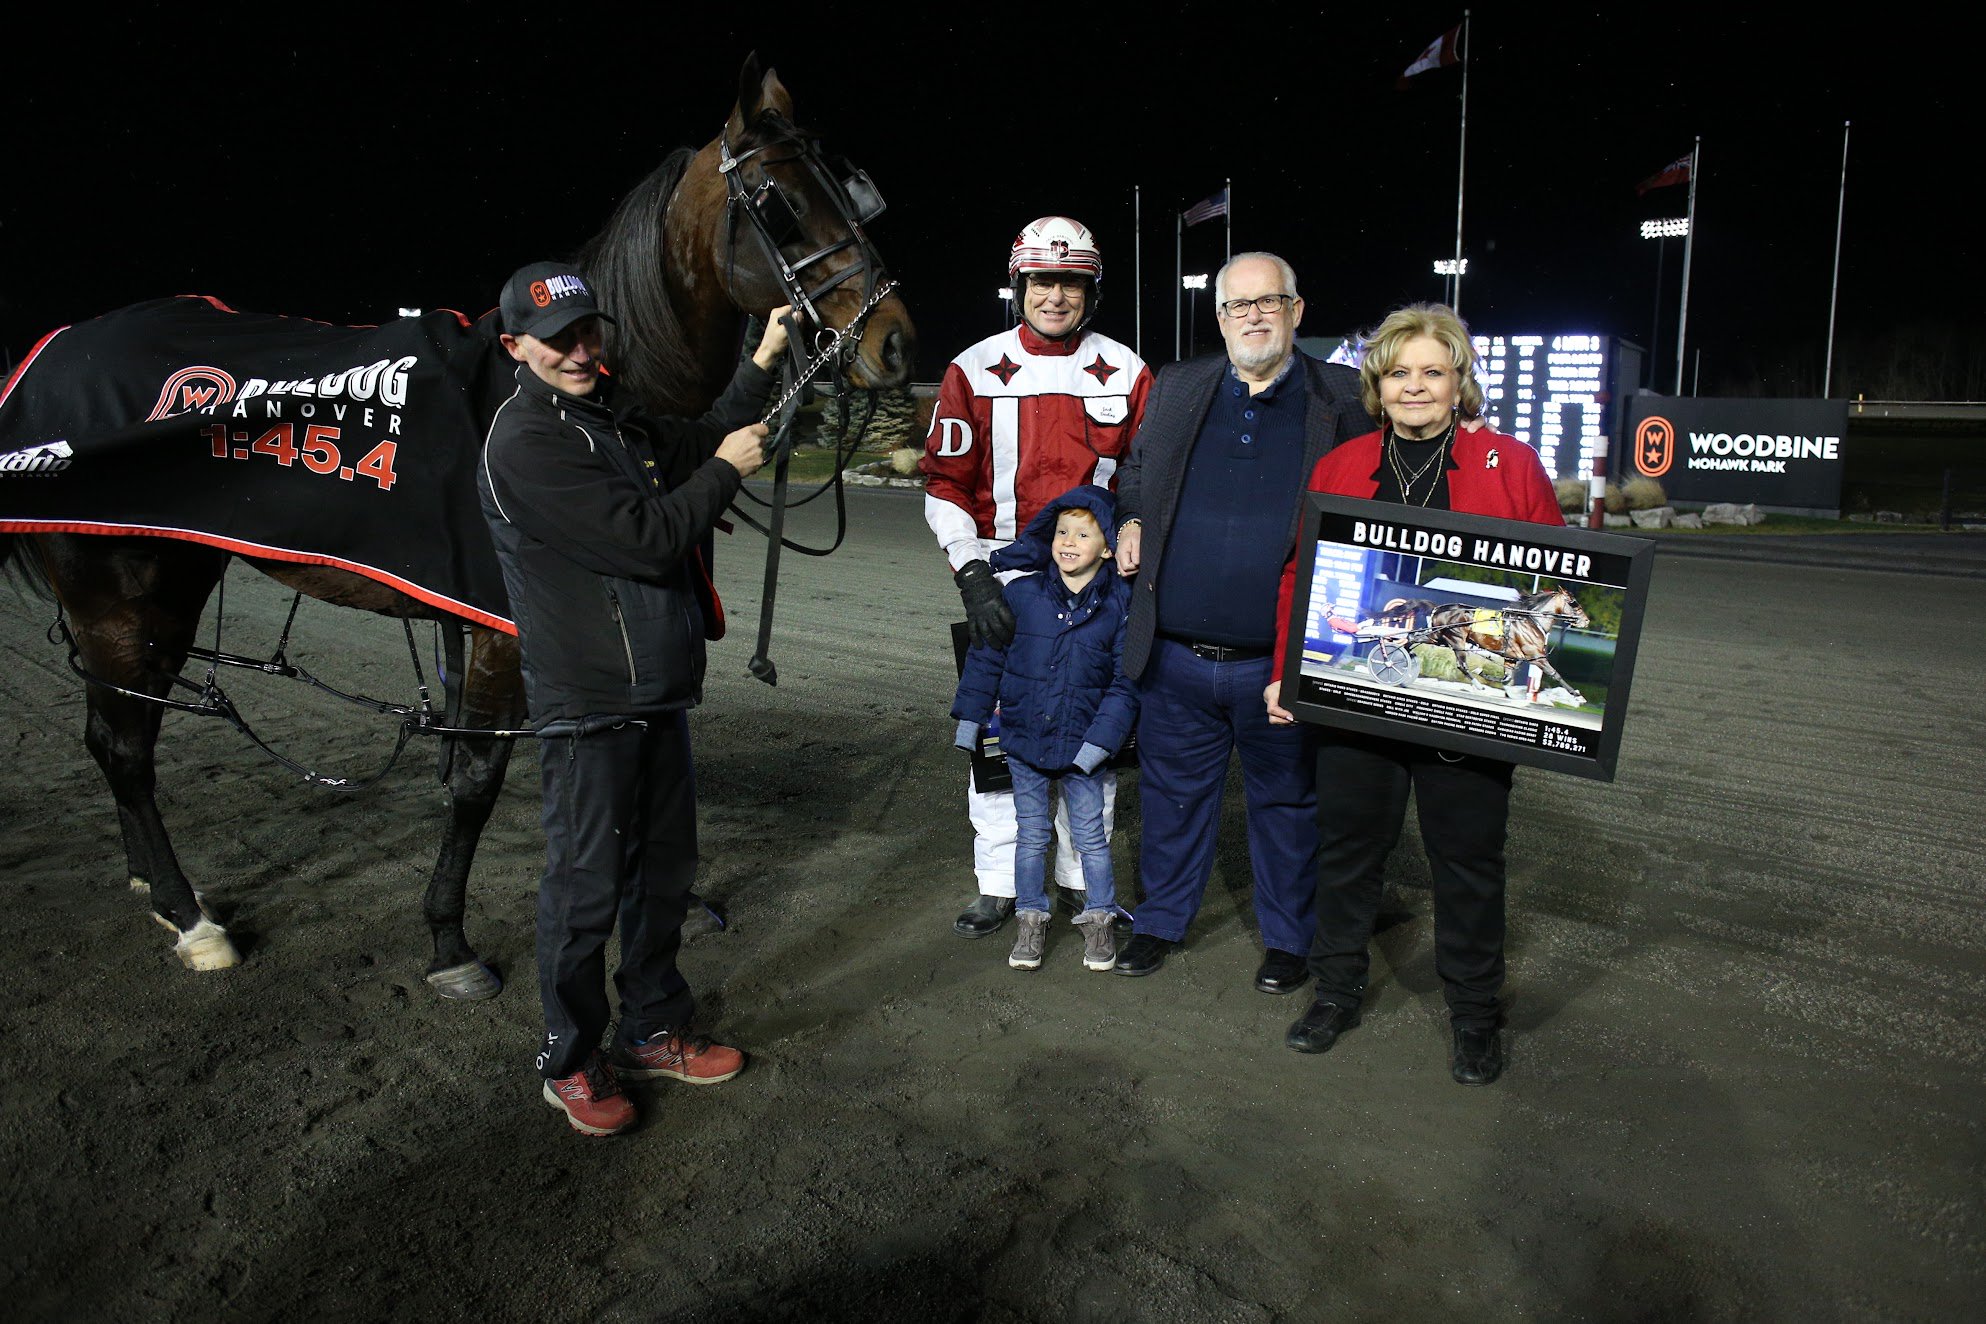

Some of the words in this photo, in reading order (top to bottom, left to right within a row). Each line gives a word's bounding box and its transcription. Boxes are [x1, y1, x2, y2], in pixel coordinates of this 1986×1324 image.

[1646, 430, 1664, 447] W
[1689, 432, 1840, 460] WOODBINE
[201, 422, 398, 491] 1:45.4
[1687, 457, 1749, 472] MOHAWK
[1751, 459, 1786, 474] PARK
[1353, 521, 1463, 558] BULLDOG
[1473, 539, 1592, 578] HANOVER
[1545, 725, 1569, 735] 1:45.4
[1557, 735, 1578, 744] WINS
